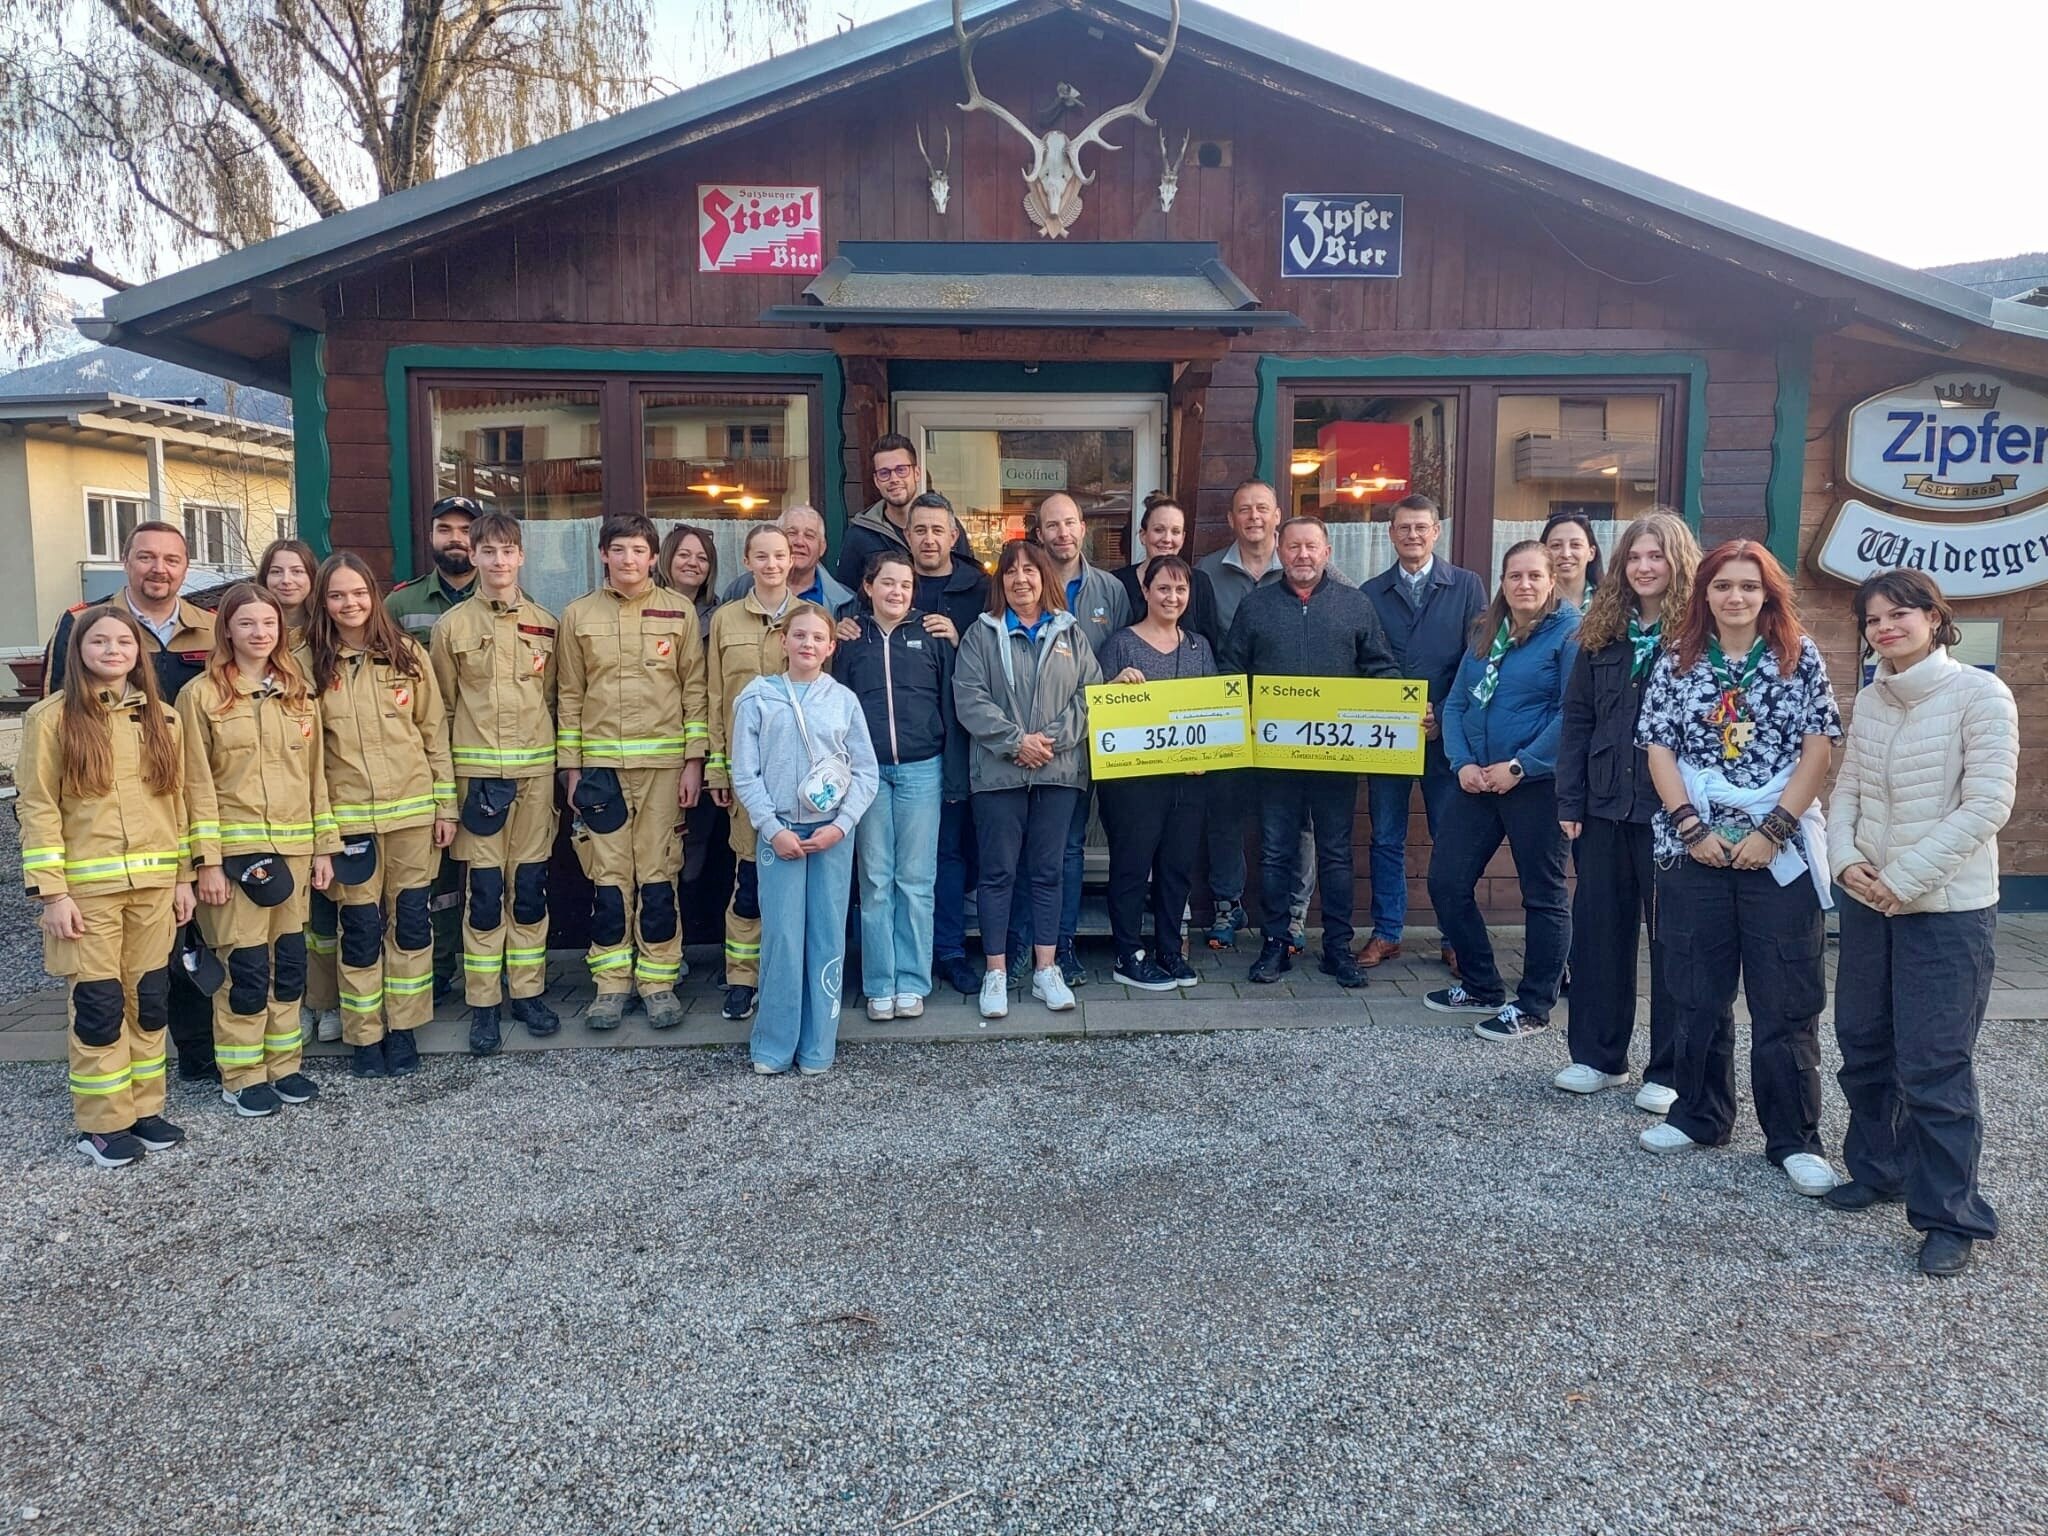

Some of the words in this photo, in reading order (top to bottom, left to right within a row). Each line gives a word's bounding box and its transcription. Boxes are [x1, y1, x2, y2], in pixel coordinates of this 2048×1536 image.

[738, 190, 796, 200] Salzburger
[701, 188, 814, 267] Stiegl
[1289, 200, 1394, 270] Zipfer
[770, 246, 818, 268] Bier
[1321, 235, 1388, 266] Bier
[1882, 411, 2048, 476] Zipfer
[1006, 467, 1059, 481] Geöffnet
[1924, 484, 1960, 497] SEIT
[1964, 484, 1997, 497] 1858
[1856, 527, 2048, 579] Waldegger
[1105, 691, 1151, 705] Scheck
[1272, 685, 1321, 698] Scheck
